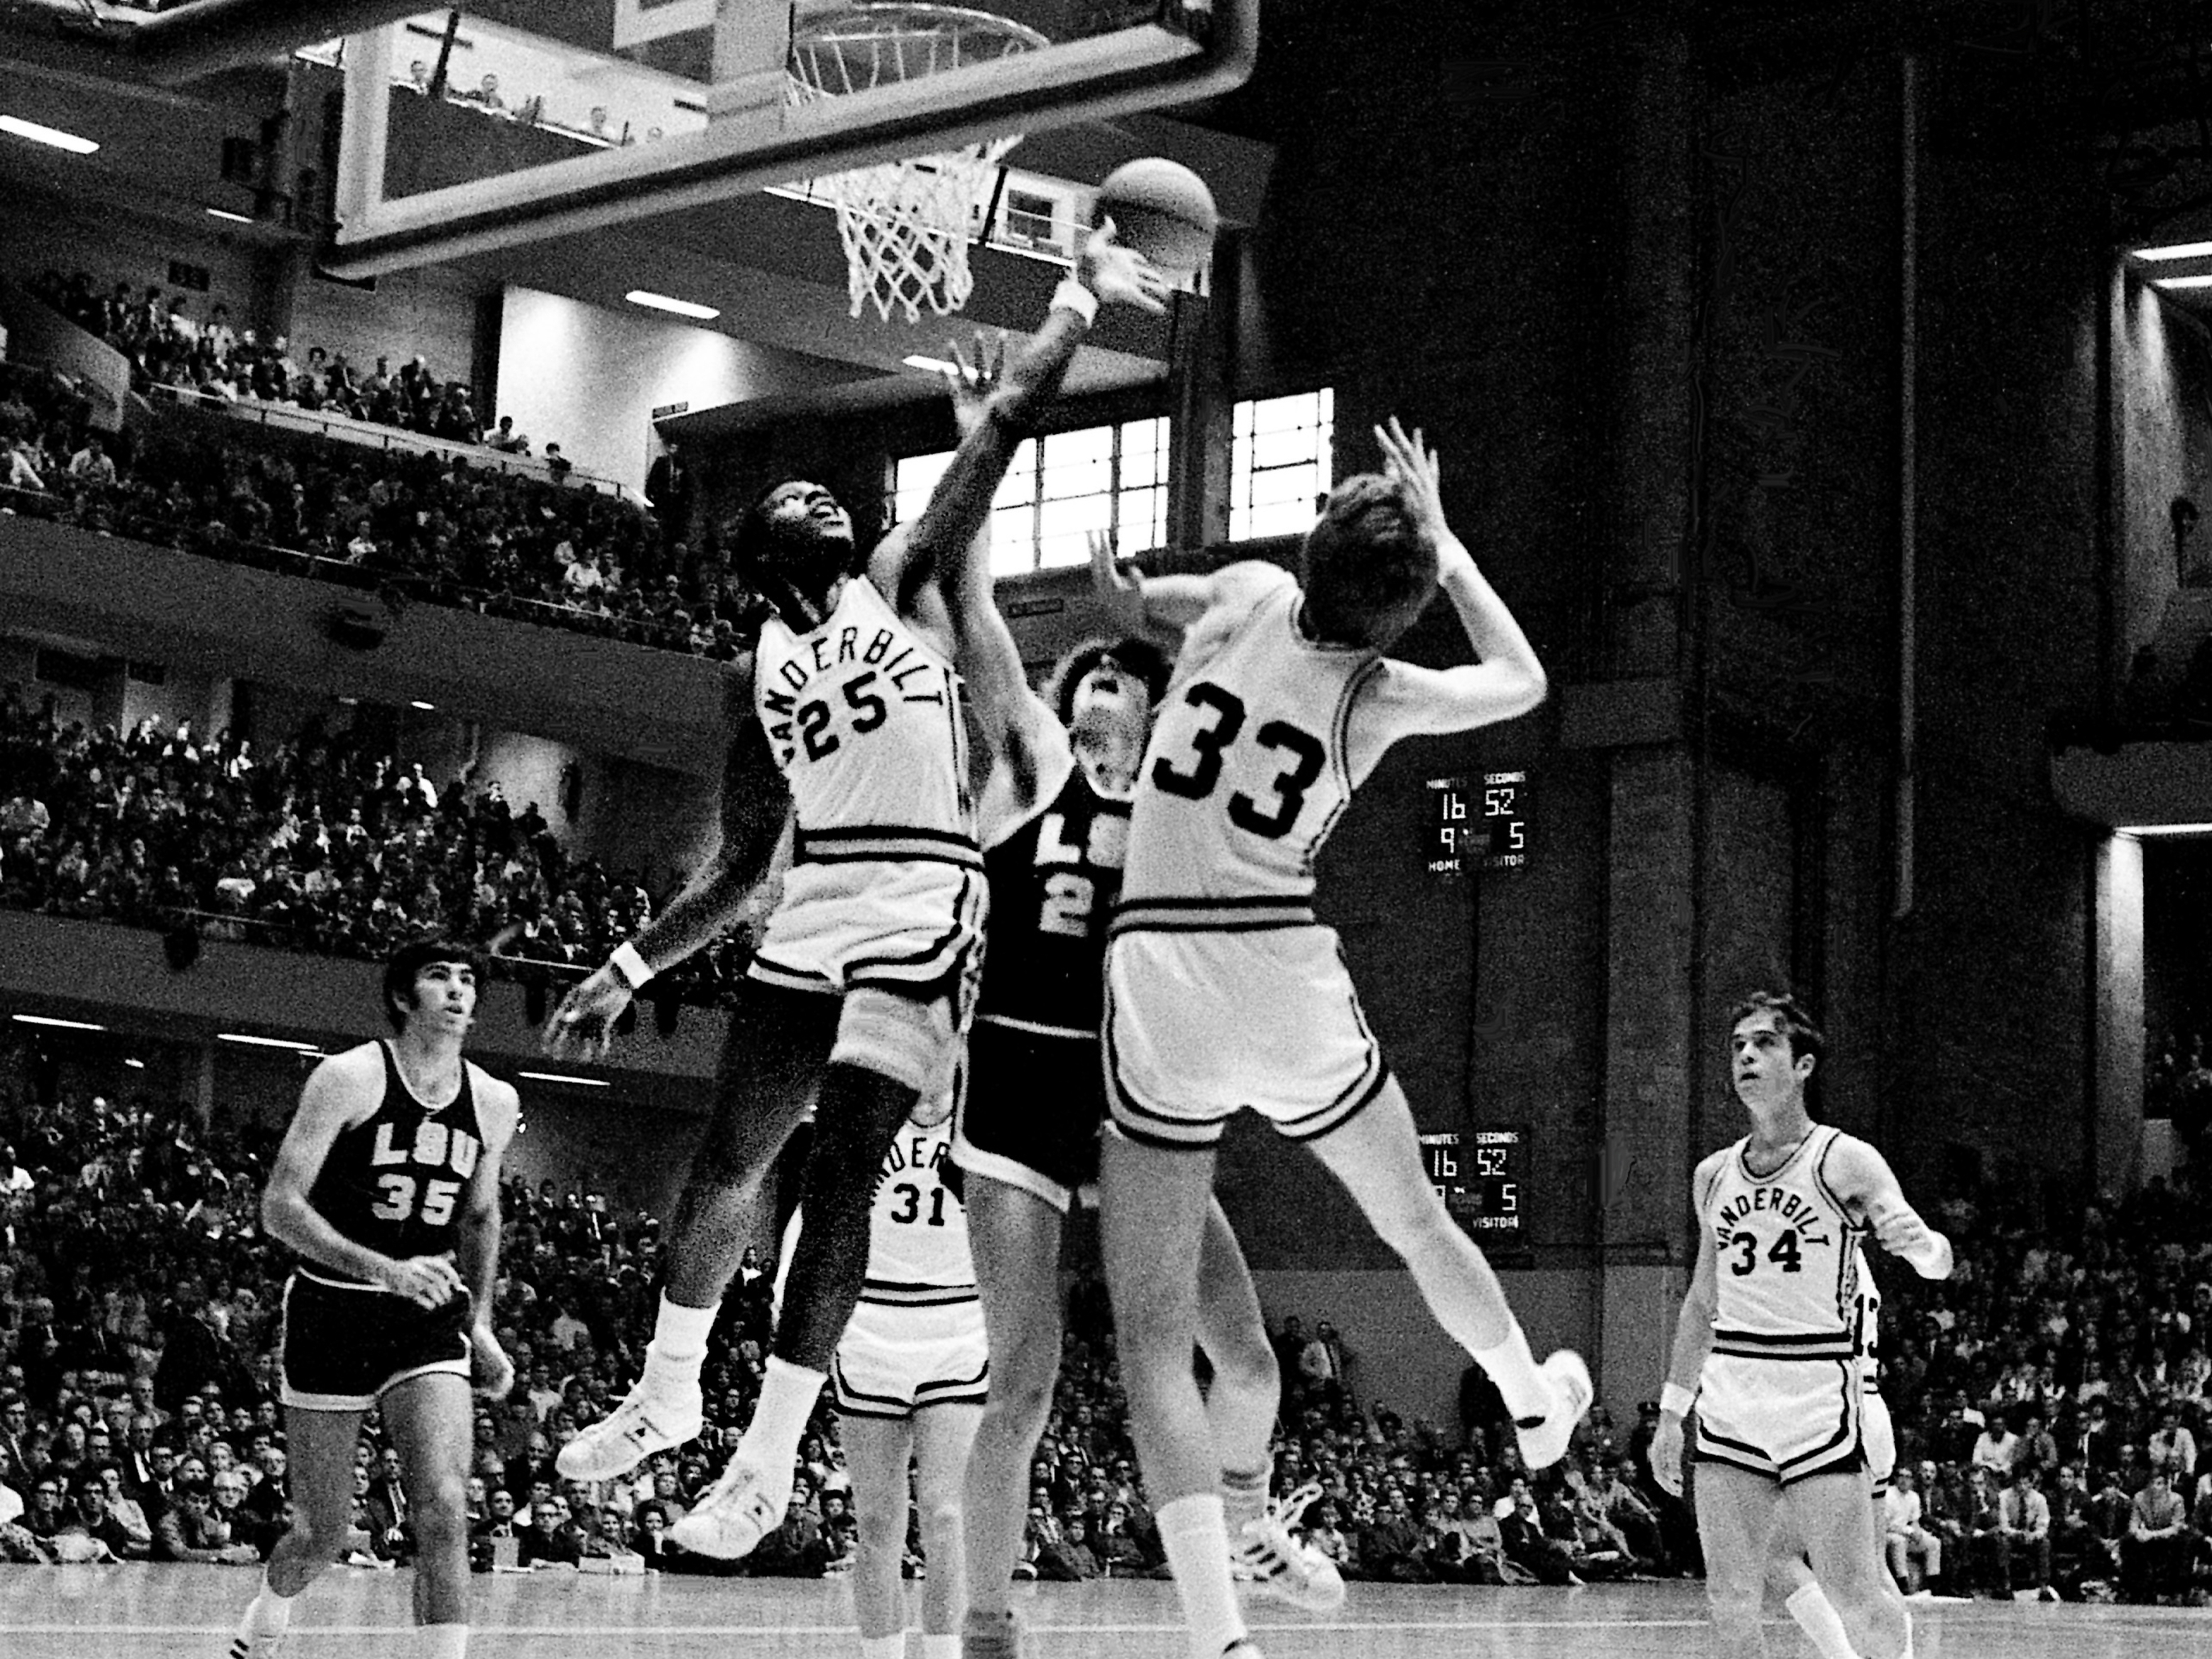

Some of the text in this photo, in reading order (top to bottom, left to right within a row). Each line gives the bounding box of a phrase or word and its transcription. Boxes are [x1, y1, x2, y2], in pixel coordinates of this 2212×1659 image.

[797, 670, 887, 762] 25
[1152, 681, 1326, 839] 33
[1483, 771, 1526, 785] SECONDS
[1443, 788, 1514, 820] 16 52
[1440, 828, 1455, 854] 9
[1510, 822, 1525, 849] 5
[1428, 859, 1461, 871] HOME
[1038, 872, 1099, 937] 2
[370, 1121, 481, 1179] LSU
[1419, 1132, 1520, 1145] MINUTES SECONDS
[1434, 1148, 1507, 1177] 16 52
[371, 1173, 462, 1226] 35
[891, 1183, 945, 1226] 31
[1502, 1184, 1517, 1211] 5
[1473, 1215, 1519, 1229] VISITOR
[1716, 1187, 1830, 1251] VANDERBILT
[1731, 1229, 1802, 1276] 34
